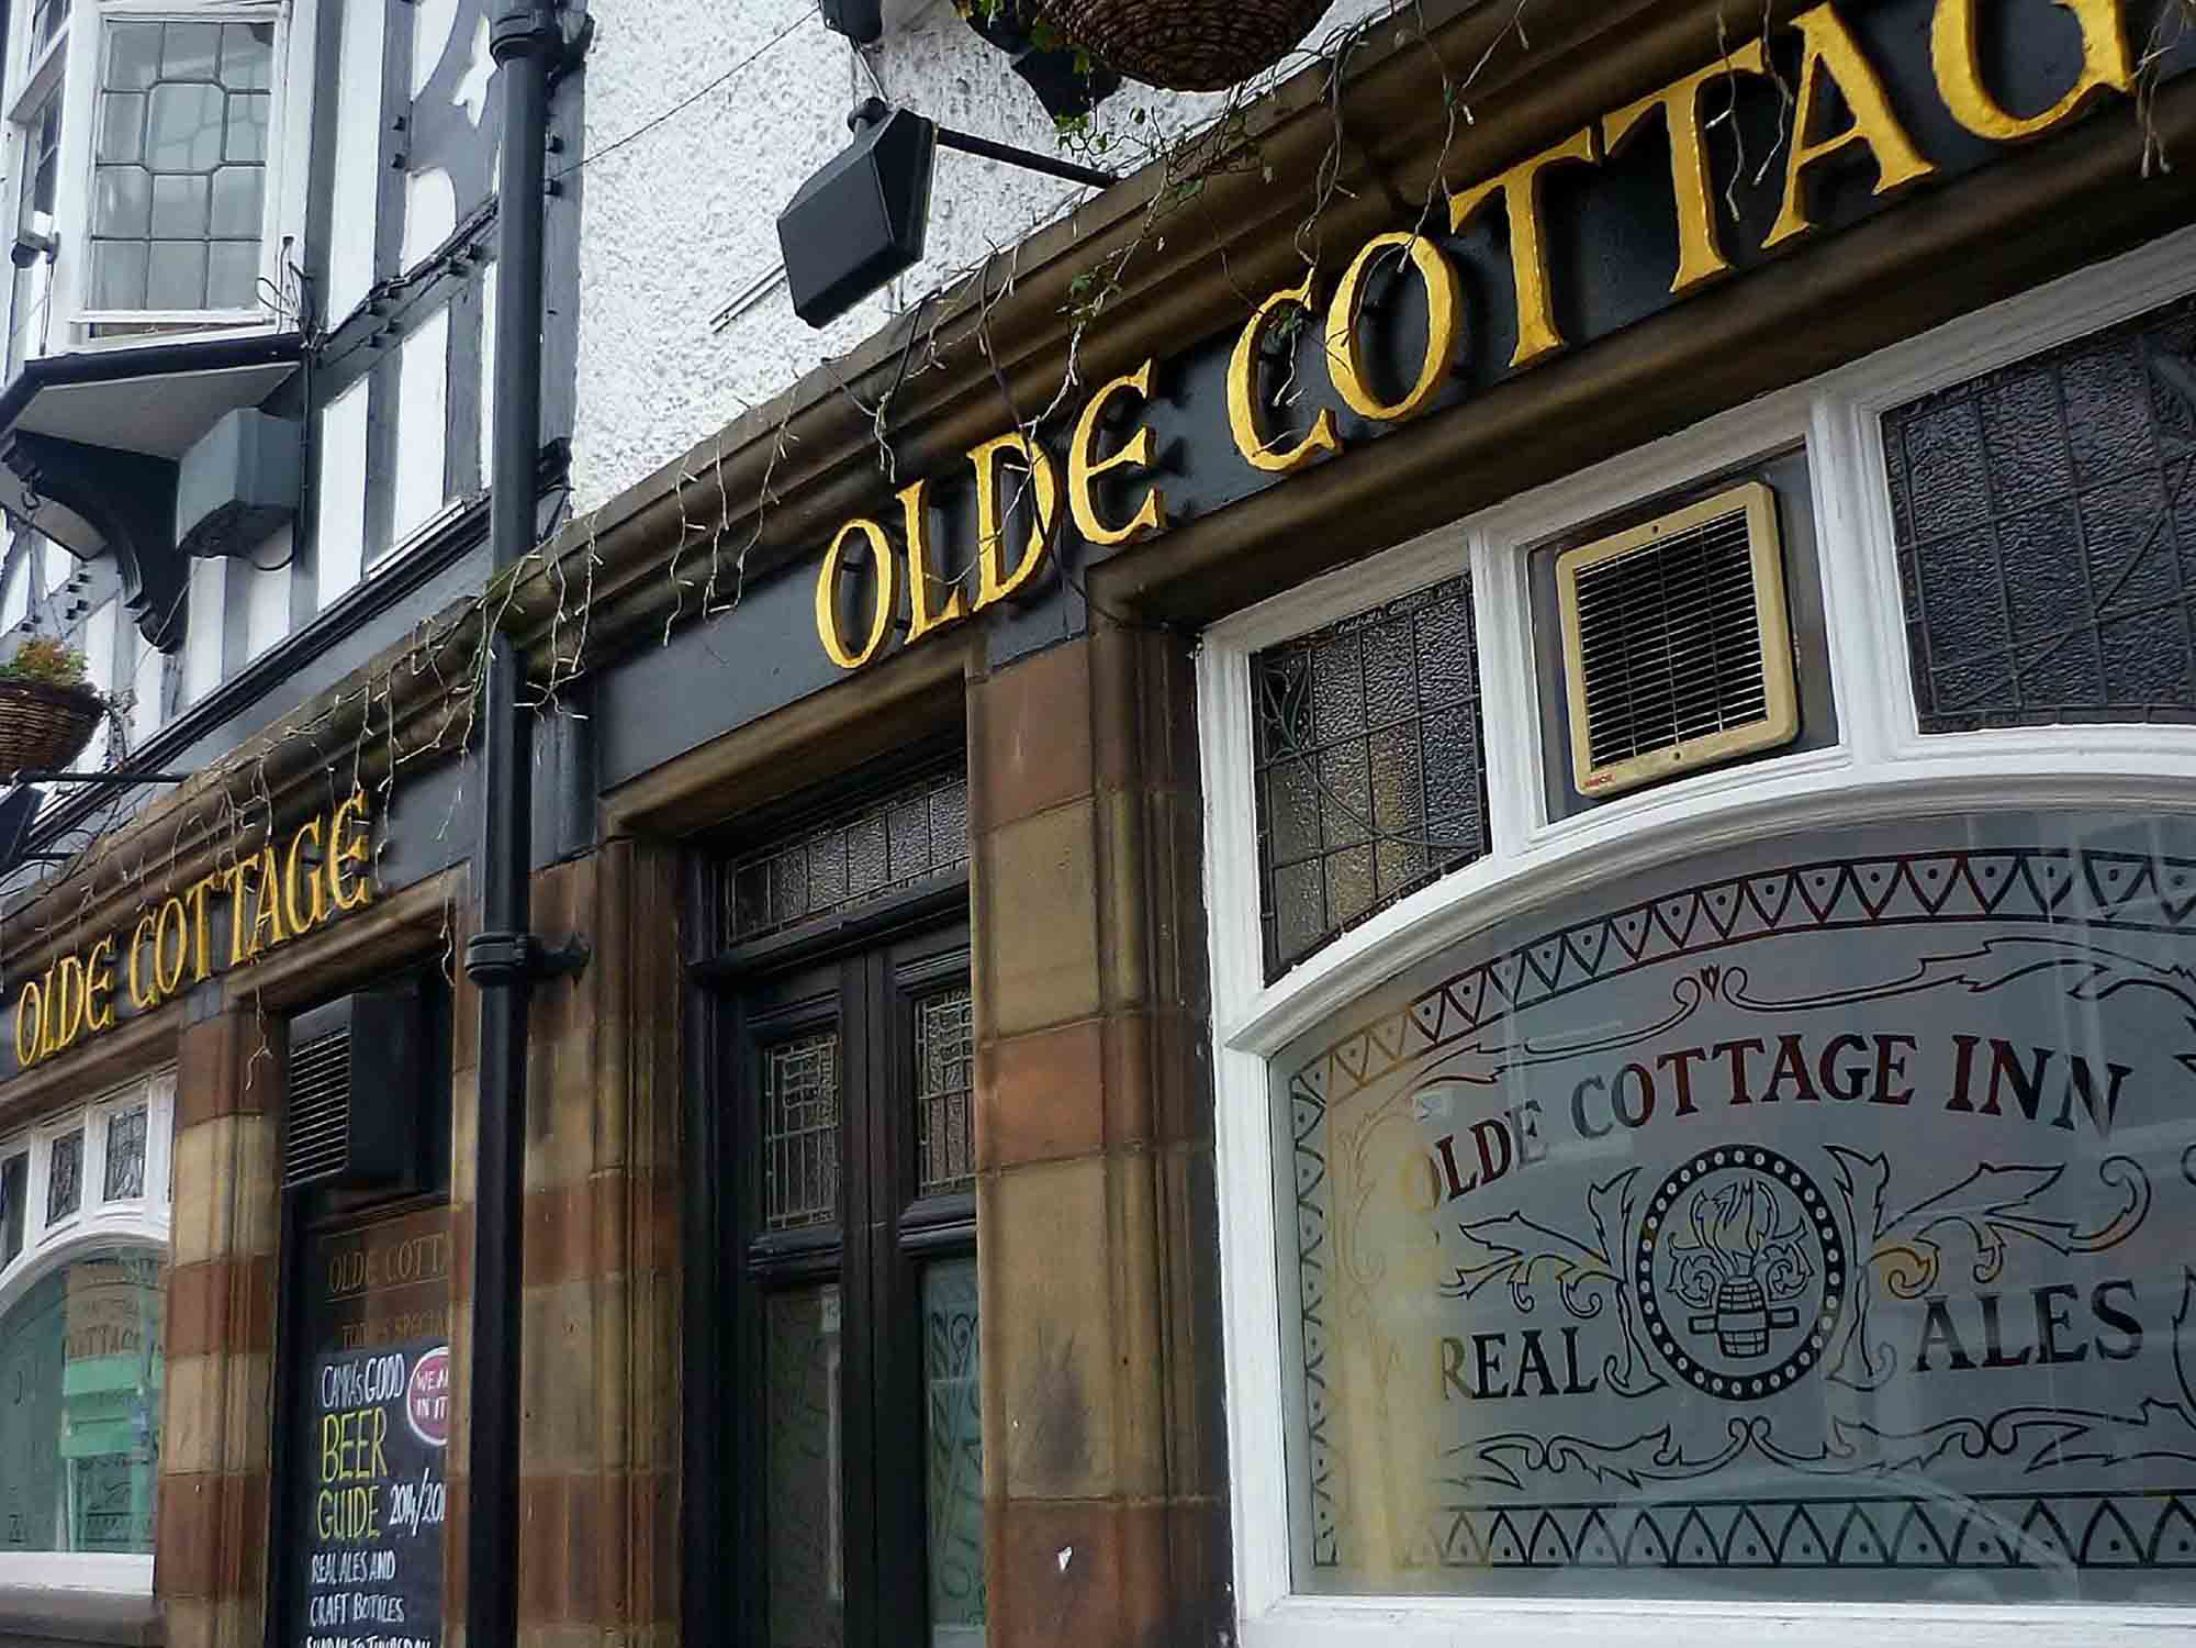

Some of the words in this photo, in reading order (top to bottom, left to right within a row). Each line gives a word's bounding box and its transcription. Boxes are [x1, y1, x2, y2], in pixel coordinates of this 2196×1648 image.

[815, 357, 1161, 669] OLDE
[16, 934, 115, 1066] OLDE
[129, 789, 370, 1008] COTTAGE
[1571, 1033, 1916, 1141] COTTAGE
[1946, 1034, 2132, 1139] INN
[386, 1232, 448, 1283] COTT
[1439, 1326, 1599, 1401] REAL
[1912, 1279, 2143, 1371] ALES
[364, 1353, 405, 1403] GOOD
[322, 1406, 387, 1483] BEER
[317, 1485, 380, 1540] GUIDE
[312, 1553, 337, 1585] REAL
[339, 1550, 368, 1582] ALES
[369, 1549, 396, 1581] AND
[310, 1592, 350, 1627] CRAFT
[353, 1591, 404, 1623] BOTTLES
